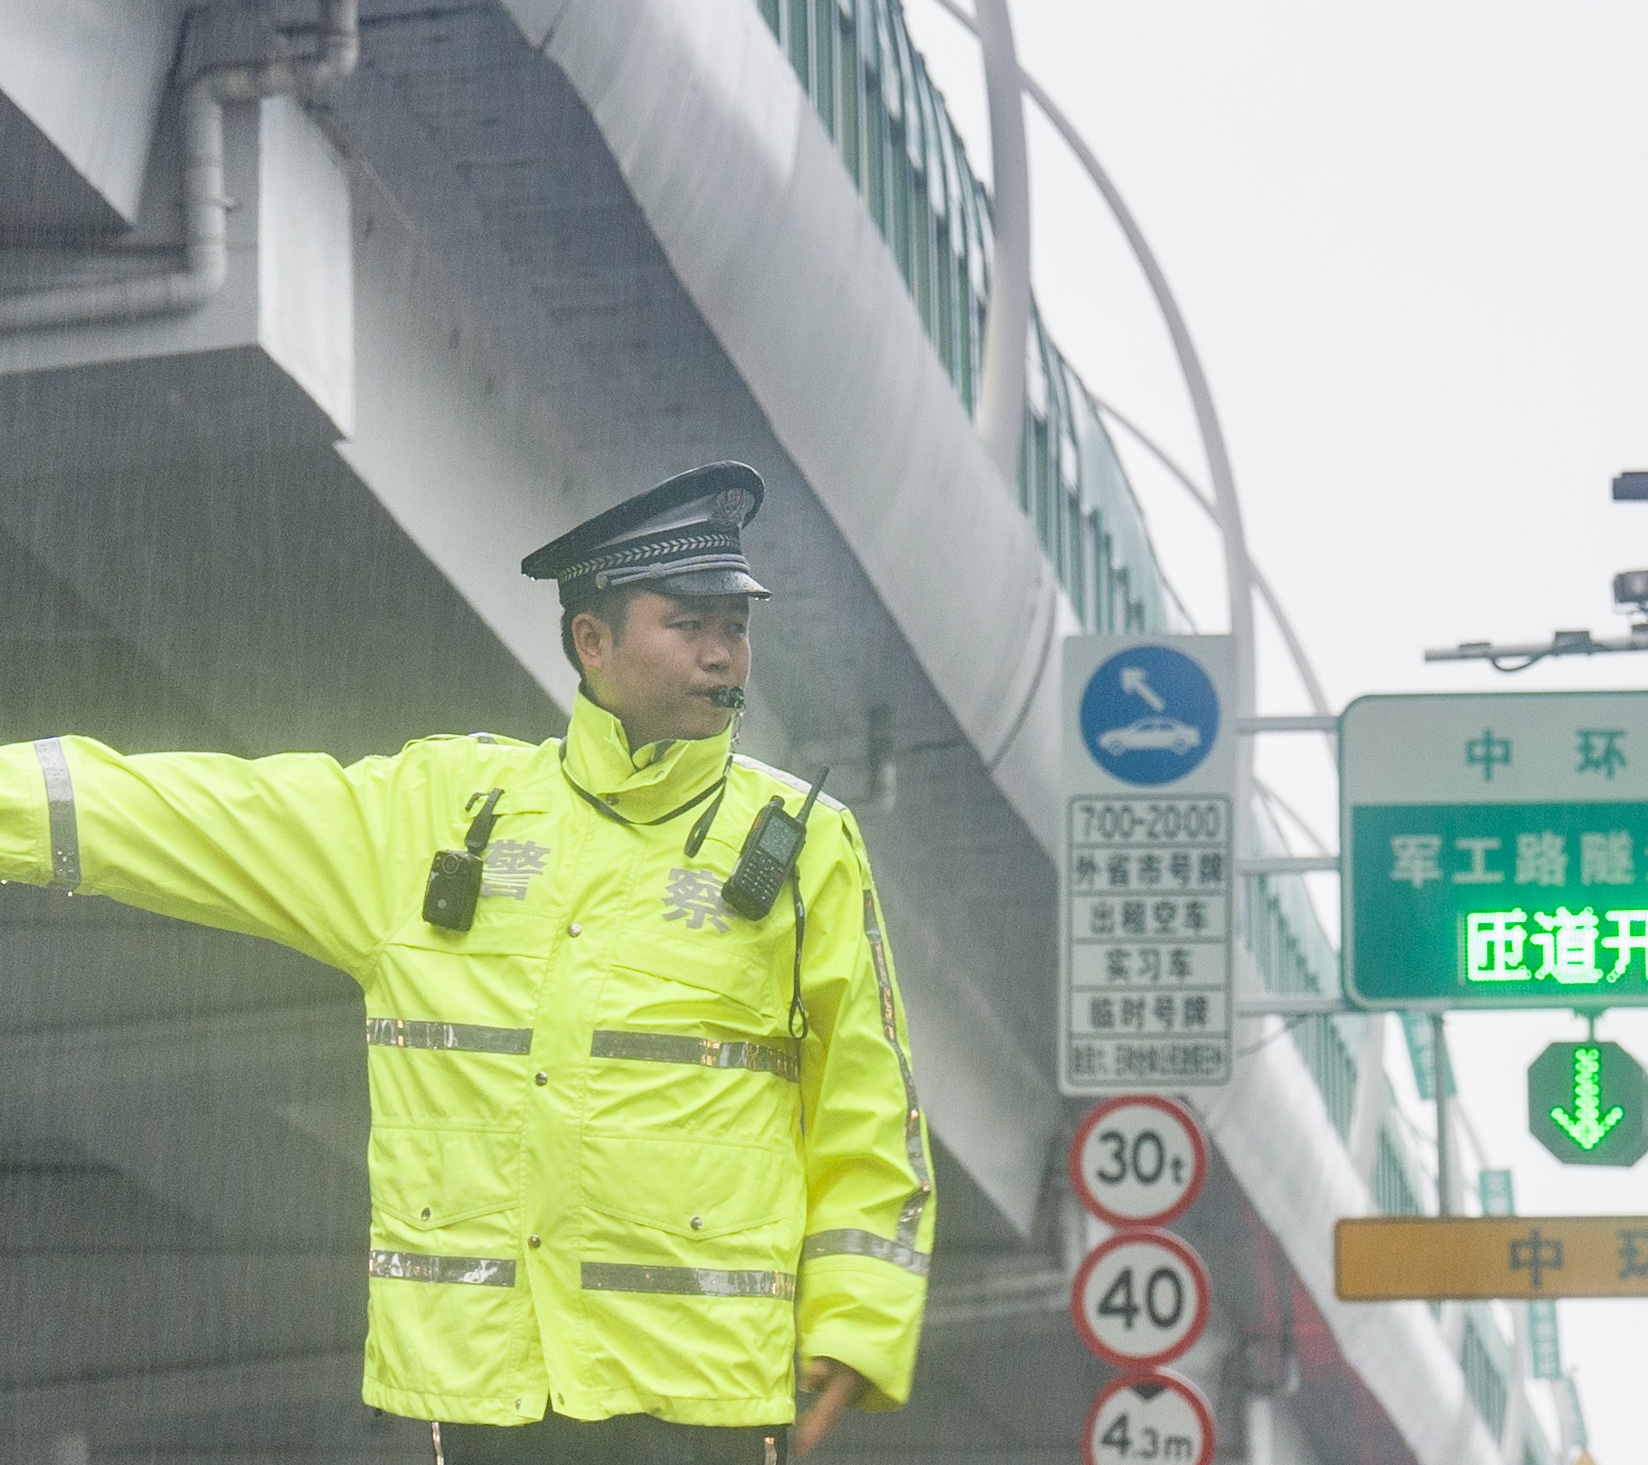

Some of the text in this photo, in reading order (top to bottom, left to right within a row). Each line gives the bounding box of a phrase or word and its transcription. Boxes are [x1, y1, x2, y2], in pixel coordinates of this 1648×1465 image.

[1105, 946, 1194, 982] 实习车
[1096, 1129, 1186, 1185] 30t
[1097, 1266, 1184, 1329] 40
[1100, 1412, 1194, 1461] 4.3m
